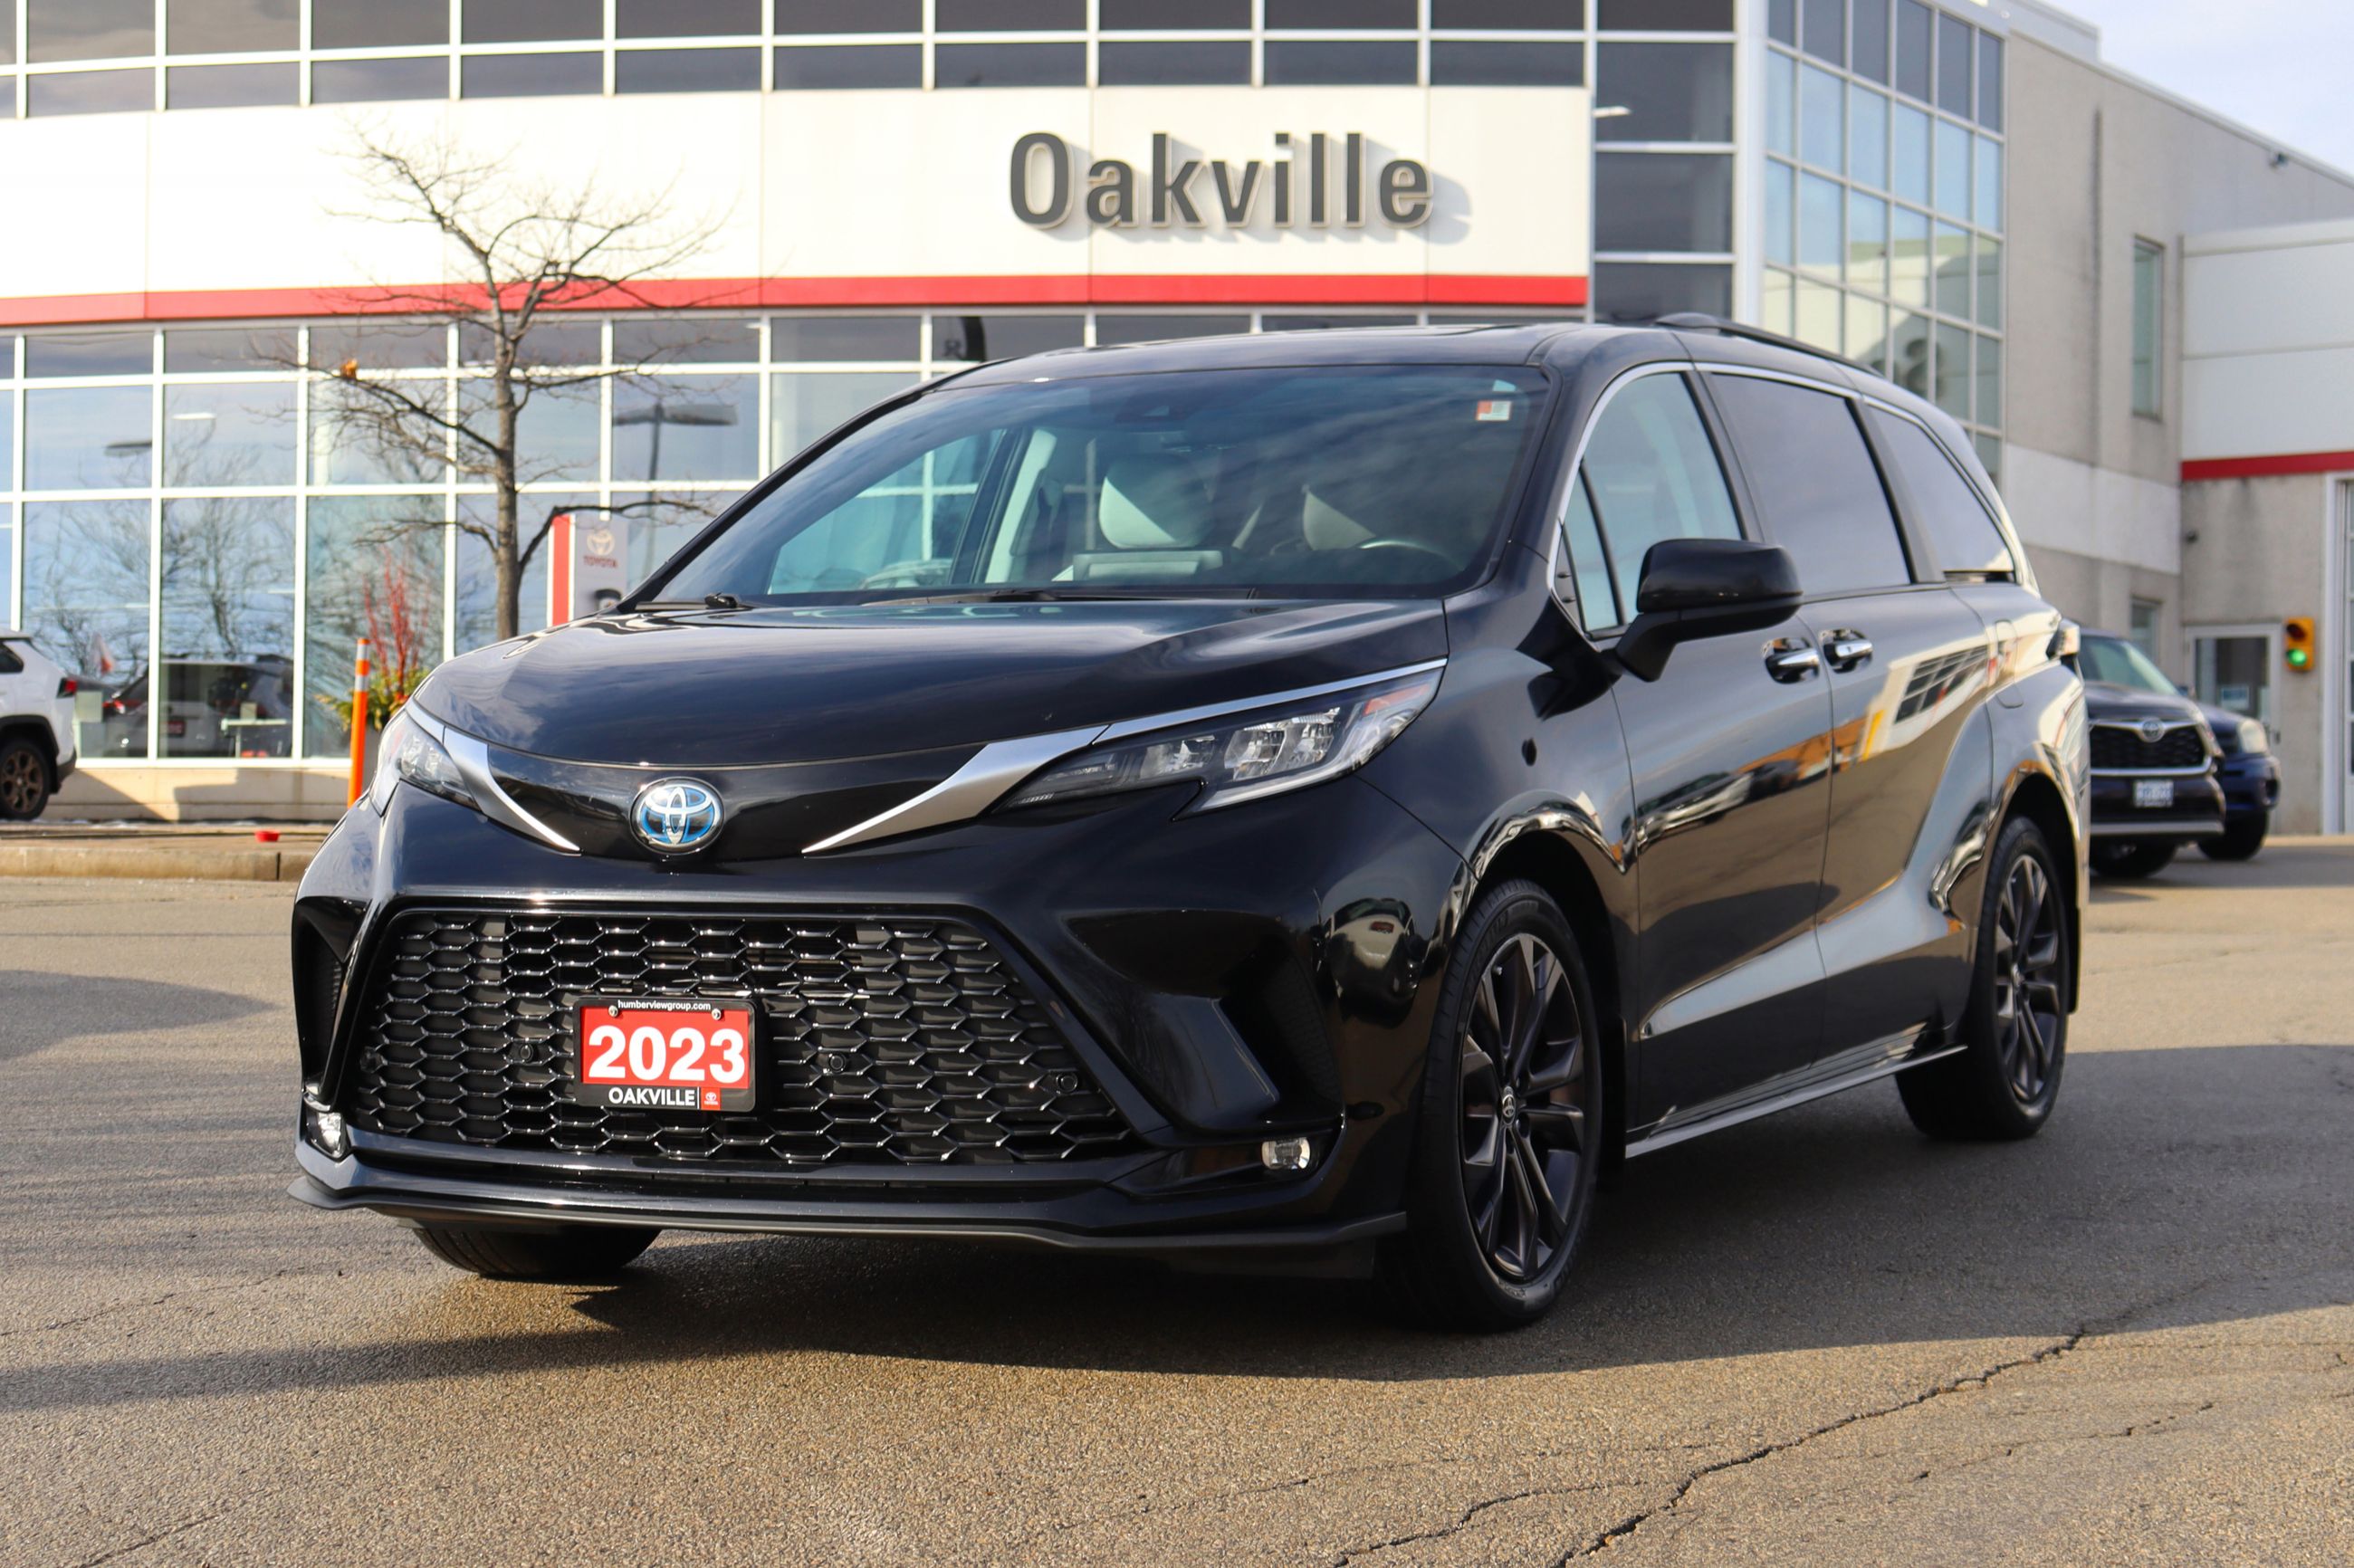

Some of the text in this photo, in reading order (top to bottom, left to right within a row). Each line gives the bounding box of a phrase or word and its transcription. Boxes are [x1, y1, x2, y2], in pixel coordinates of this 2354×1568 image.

[1010, 131, 1433, 229] Oakville
[617, 999, 712, 1011] humberviewgroup.com
[588, 1025, 745, 1084] 2023
[608, 1086, 695, 1106] OAKVILLE
